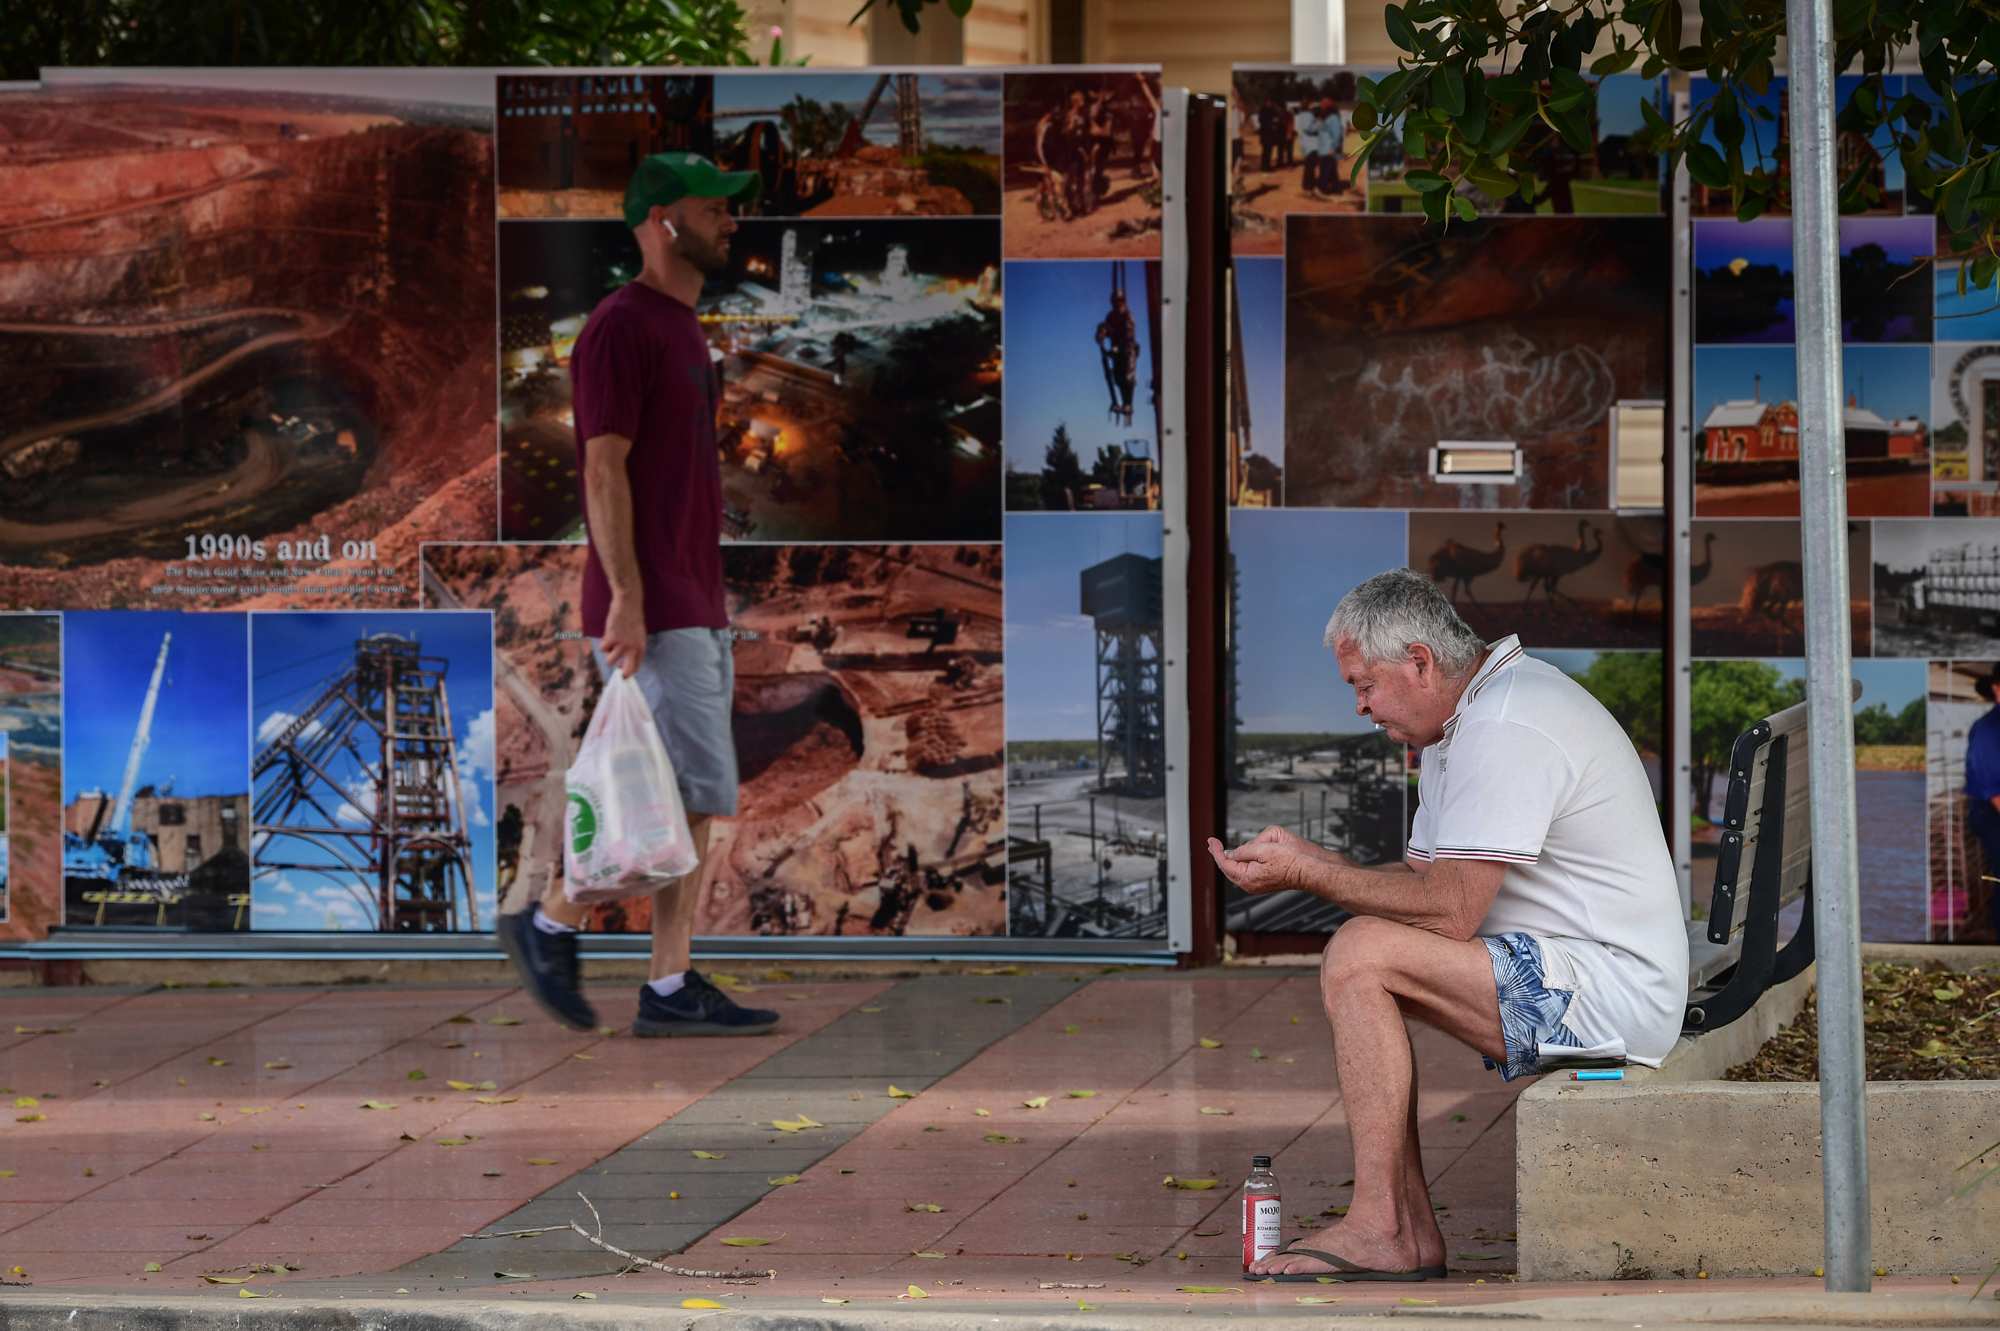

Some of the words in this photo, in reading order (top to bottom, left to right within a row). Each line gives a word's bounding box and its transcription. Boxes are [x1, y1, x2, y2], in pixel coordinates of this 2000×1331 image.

[184, 533, 267, 561] 1990s
[276, 534, 331, 561] and
[342, 540, 377, 561] on
[1260, 1206, 1280, 1216] MOJO
